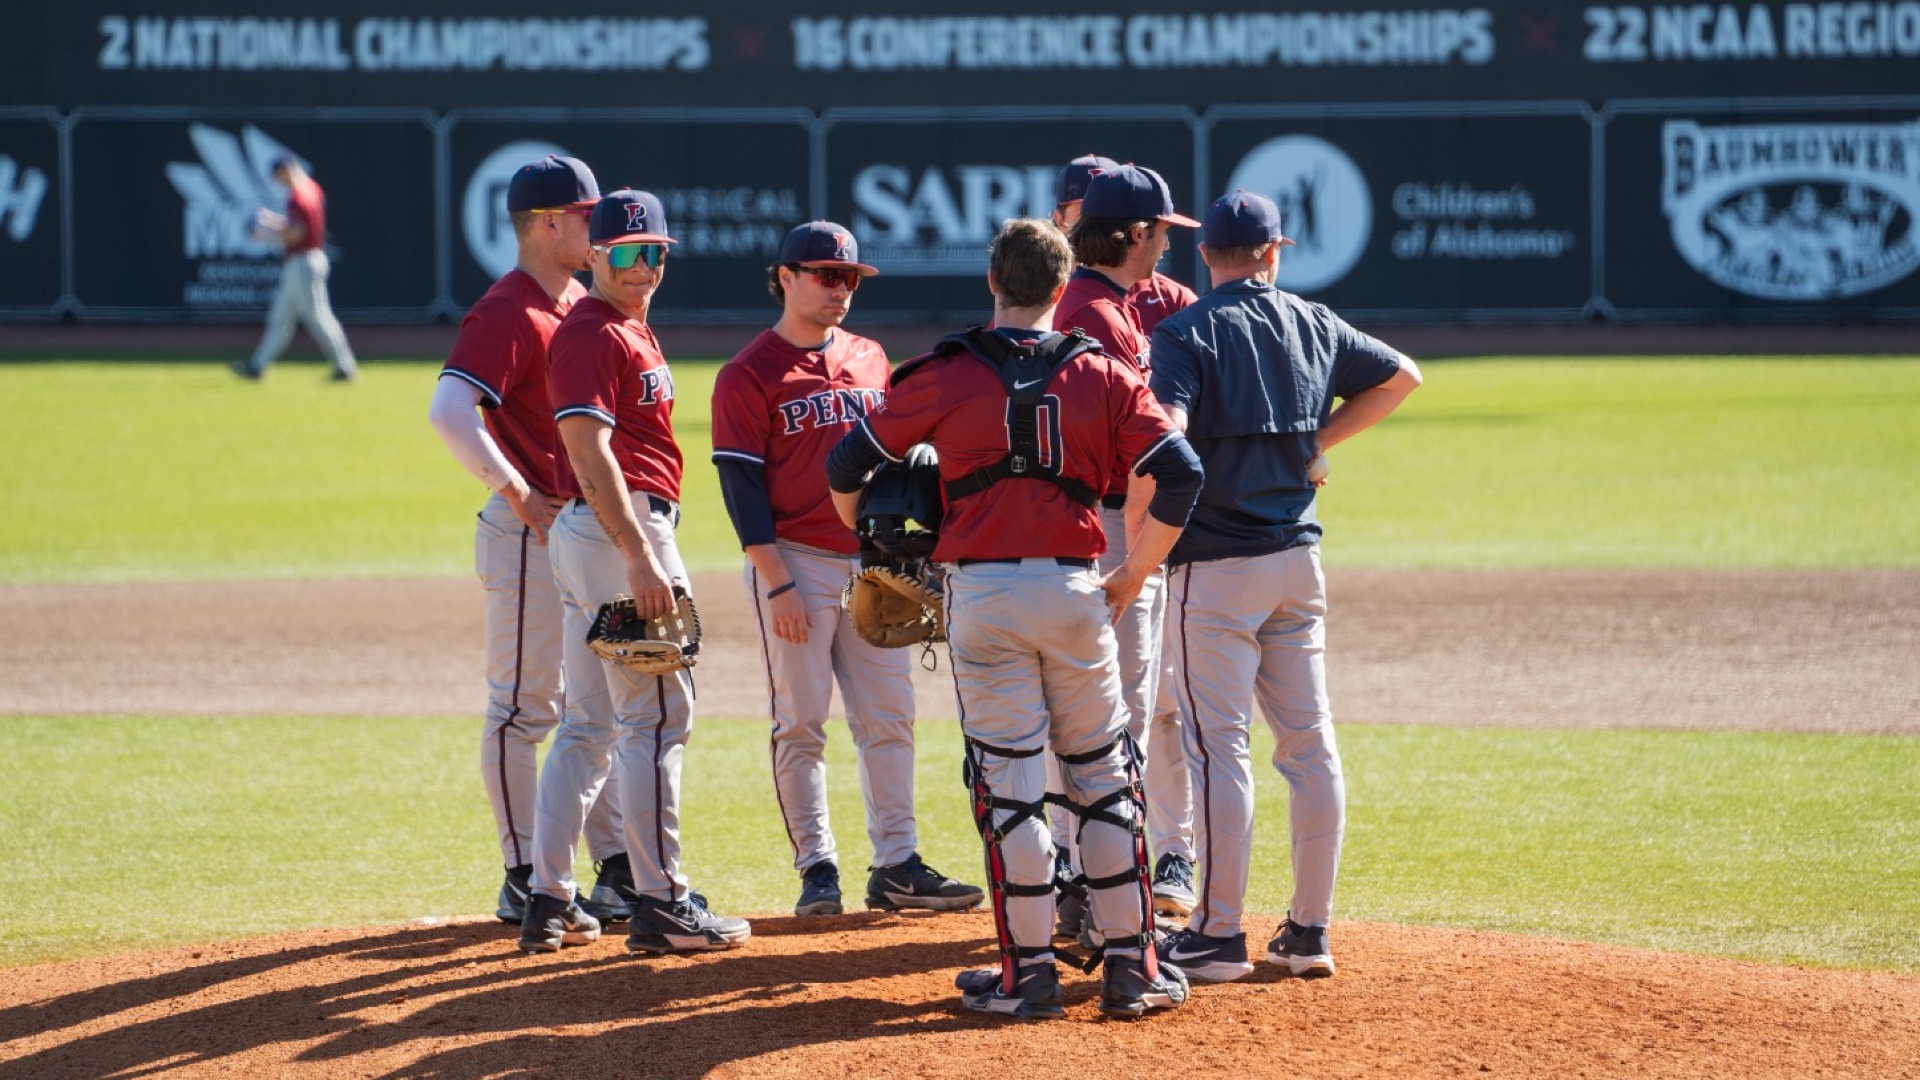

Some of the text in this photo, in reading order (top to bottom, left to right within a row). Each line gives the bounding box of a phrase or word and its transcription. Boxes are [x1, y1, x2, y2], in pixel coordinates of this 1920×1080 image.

[101, 16, 709, 70] 2 NATIONAL CHAMPIONSHIPS
[791, 9, 1495, 70] 16 CONFERENCE CHAMPIONSHIPS
[1584, 5, 1646, 61] 22
[1652, 3, 1776, 59] NCAA
[623, 203, 648, 231] P
[662, 187, 800, 221] YSICAL
[1393, 182, 1536, 220] Children's
[669, 222, 784, 257] ERAPY
[1392, 220, 1427, 259] of
